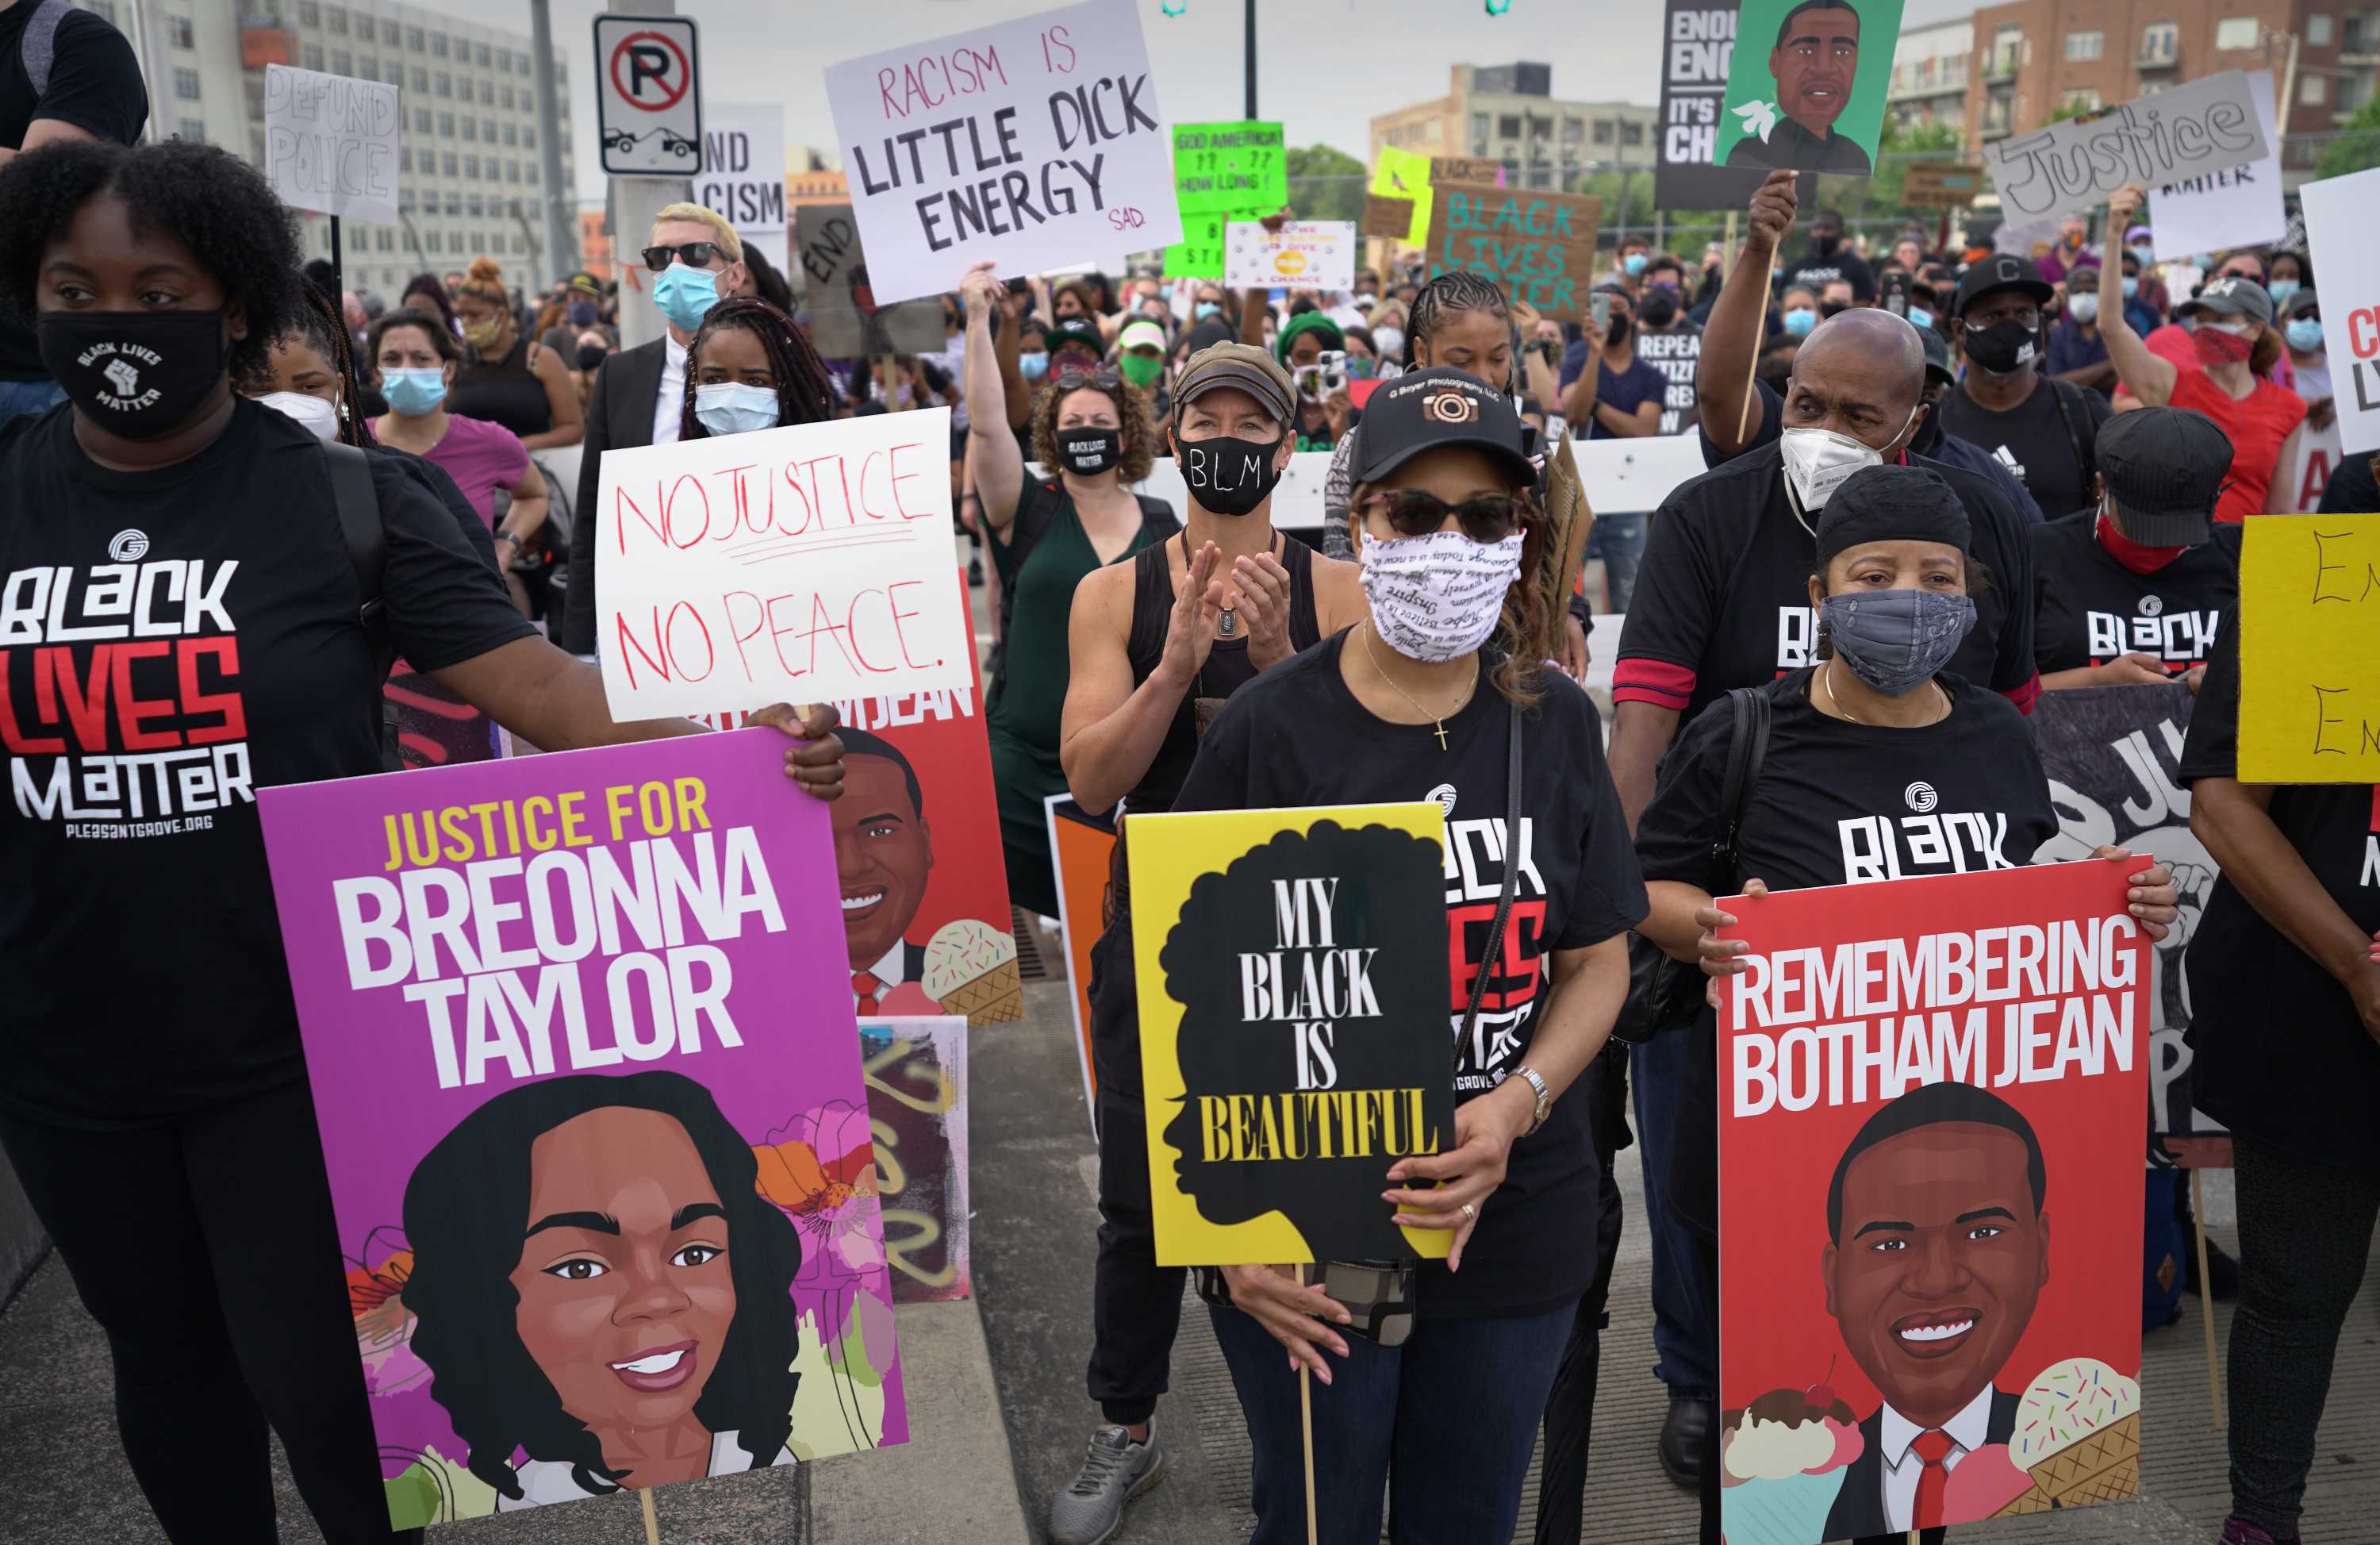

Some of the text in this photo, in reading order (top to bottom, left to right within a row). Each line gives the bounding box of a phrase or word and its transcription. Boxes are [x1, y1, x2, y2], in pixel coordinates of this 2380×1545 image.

[267, 67, 397, 136] DEFUND
[631, 46, 670, 95] P
[877, 25, 1076, 119] RACISM IS
[852, 73, 1159, 197] LITTLE DICK
[1669, 98, 1715, 123] IT'S
[270, 126, 389, 197] POLICE
[706, 131, 750, 173] ND
[2000, 101, 2254, 214] Justice
[704, 182, 784, 223] CISM
[915, 152, 1106, 253] ENERGY
[1447, 191, 1575, 238] BLACK
[803, 217, 852, 284] END
[1444, 234, 1567, 277] LIVES
[1997, 259, 2020, 281] C
[77, 342, 163, 367] BLACK LIVES
[1638, 334, 1700, 356] REPEA
[96, 388, 162, 412] MATTER
[1389, 389, 1398, 398] G
[1399, 382, 1426, 395] Boyer
[616, 443, 934, 555] NO JUSTICE
[1190, 448, 1261, 491] BLM
[616, 600, 714, 690] NO
[0, 636, 248, 754] LIVES
[383, 776, 712, 871] JUSTICE FOR
[332, 824, 787, 990] BREONNA
[1271, 877, 1339, 950] MY
[1238, 948, 1383, 1022] BLACK
[1732, 913, 2137, 1031] REMEMBERING
[402, 944, 745, 1089] TAYLOR
[1294, 1021, 1337, 1090] IS
[1733, 1007, 1989, 1119] BOTHAM
[1994, 991, 2134, 1087] JEAN
[1196, 1088, 1439, 1164] BEAUTIFUL
